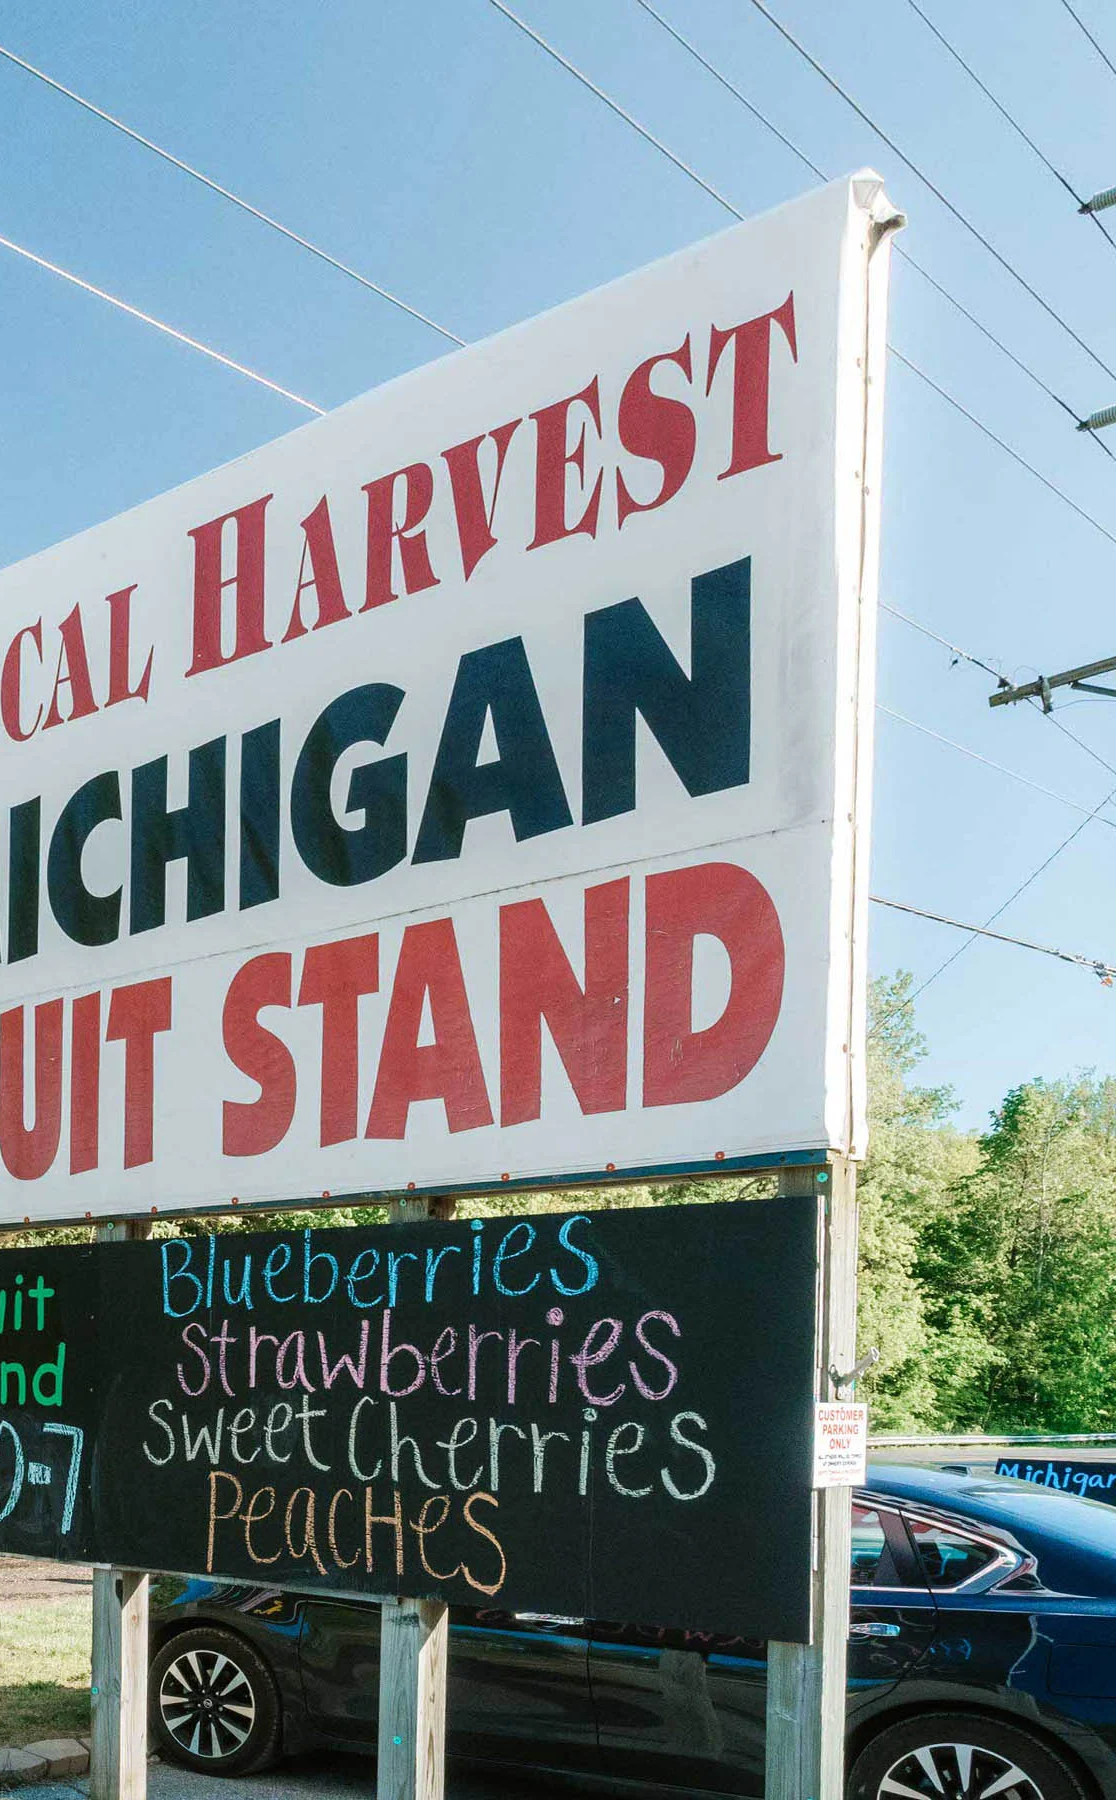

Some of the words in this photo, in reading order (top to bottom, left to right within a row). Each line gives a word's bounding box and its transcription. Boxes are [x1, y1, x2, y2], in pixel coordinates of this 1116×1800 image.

[185, 290, 799, 678] HARVEST
[222, 861, 786, 1157] STAND
[161, 1215, 600, 1318] Blueberries
[178, 1308, 681, 1406] Strawberries
[142, 1394, 332, 1472] Sweet
[347, 1395, 716, 1501] Cherries
[818, 1409, 864, 1421] CUSTOMER
[822, 1423, 859, 1435] PARKING
[829, 1438, 852, 1450] ONLY
